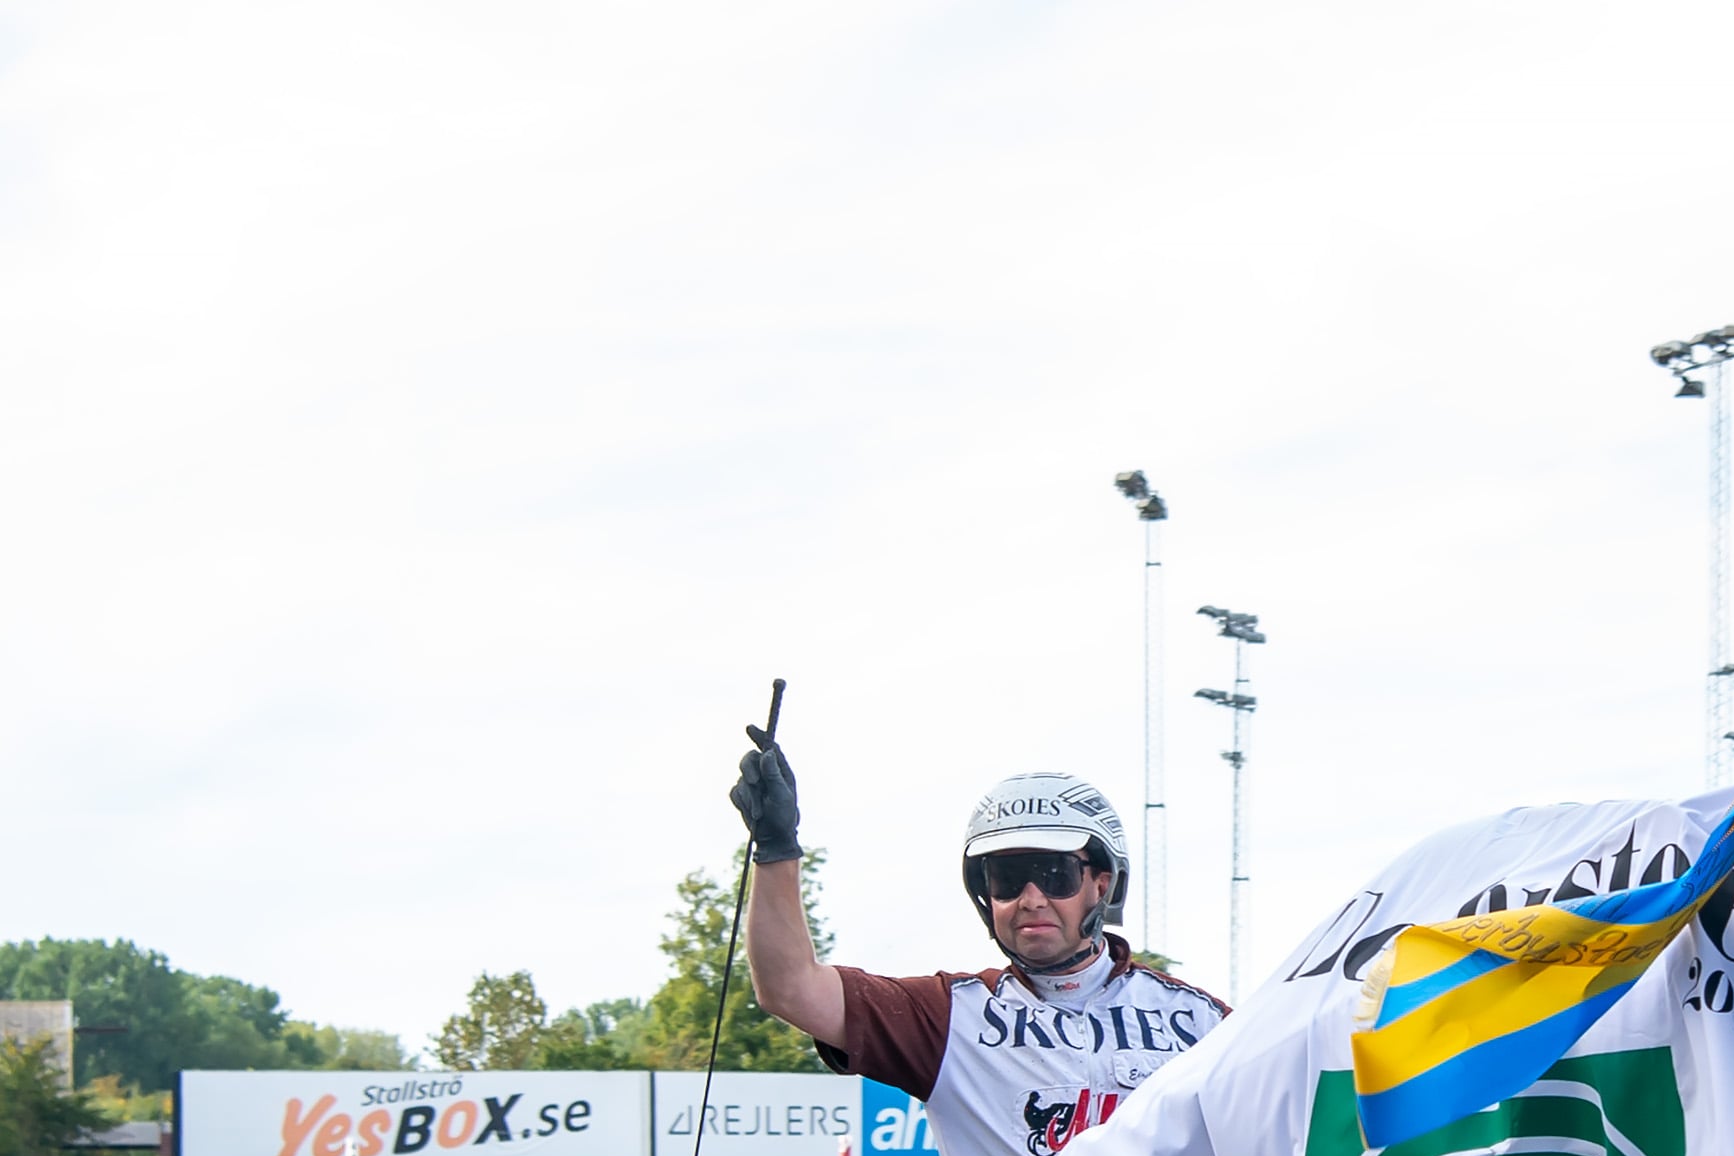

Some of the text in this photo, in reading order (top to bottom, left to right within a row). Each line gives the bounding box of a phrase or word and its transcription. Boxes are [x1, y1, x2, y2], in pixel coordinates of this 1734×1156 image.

[987, 797, 1061, 823] SKOIES
[978, 996, 1199, 1053] SKOIES
[361, 1076, 463, 1107] Stallströ
[703, 1105, 850, 1136] REJLERS
